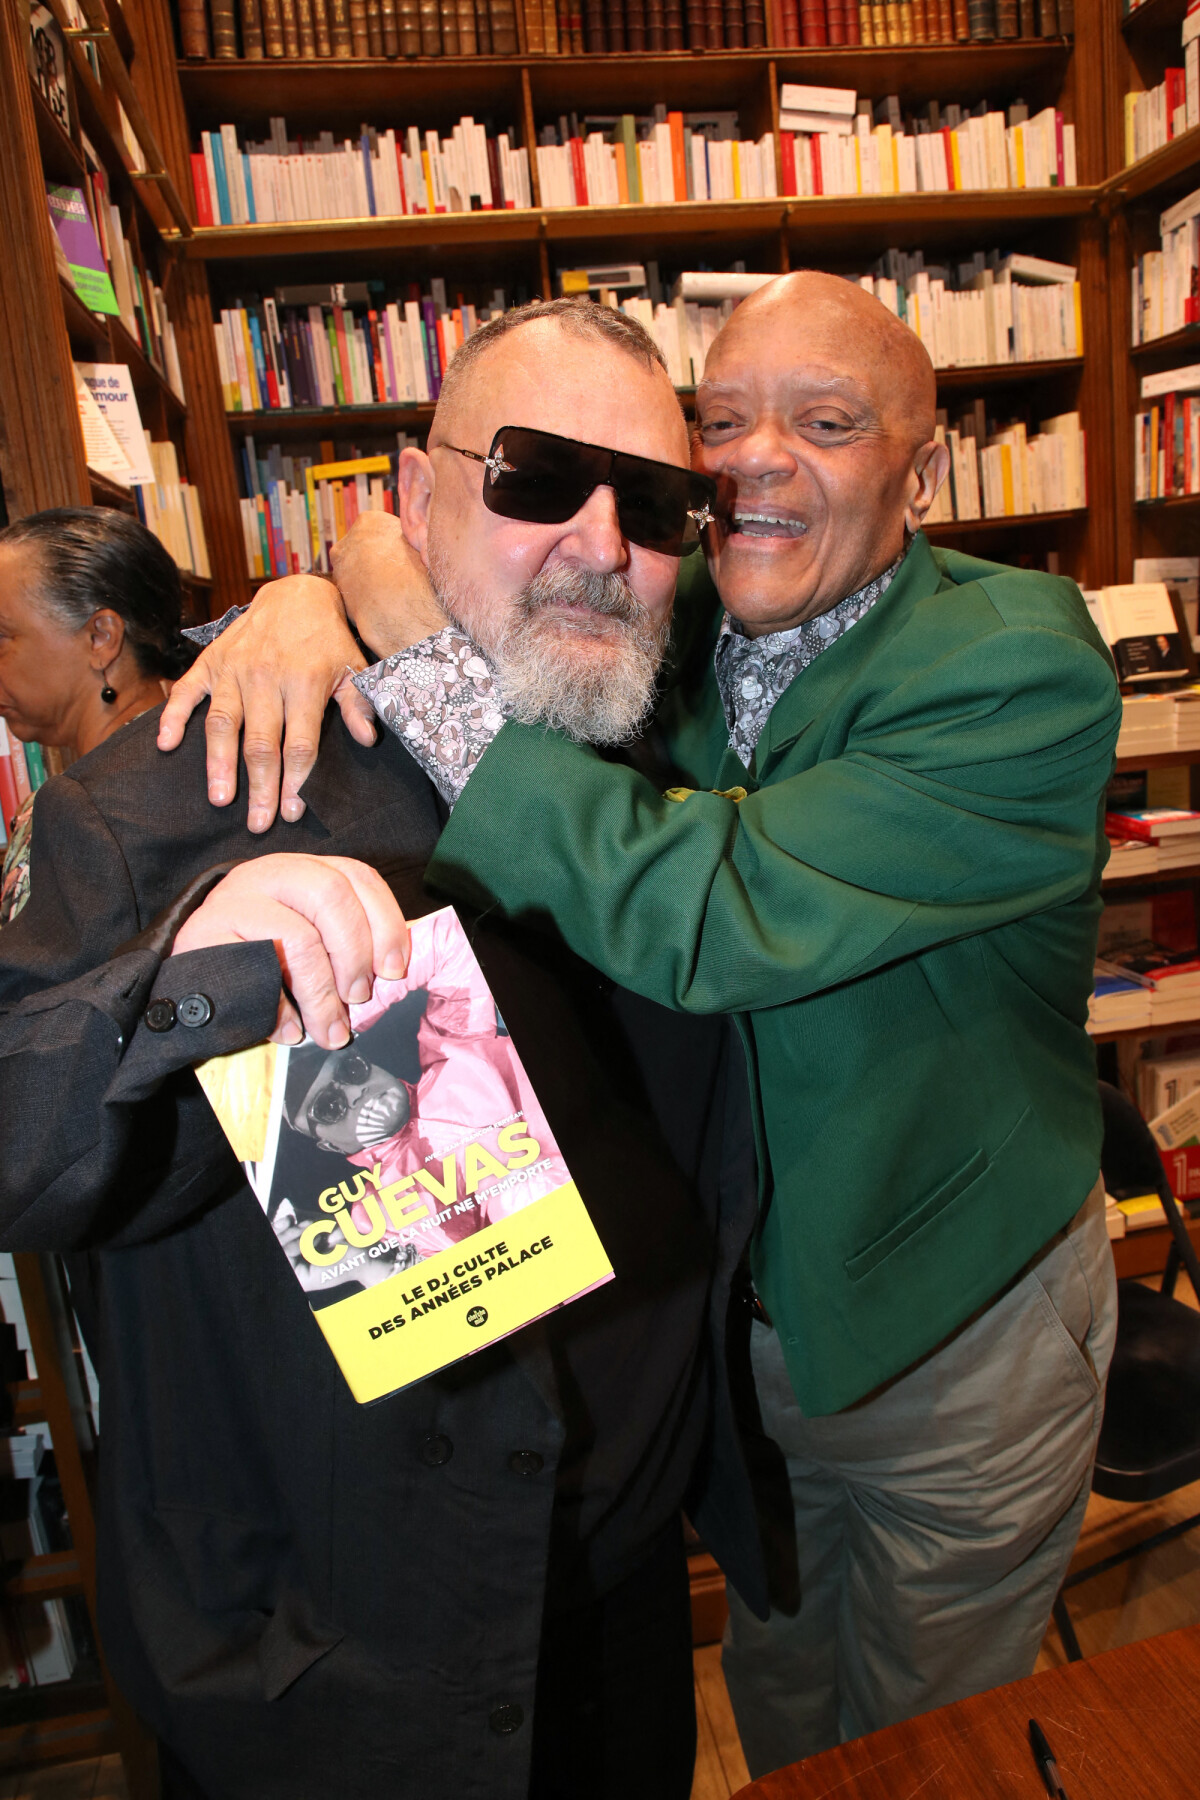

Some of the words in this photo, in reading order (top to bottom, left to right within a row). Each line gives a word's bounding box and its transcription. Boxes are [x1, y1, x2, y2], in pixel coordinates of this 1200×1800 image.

[108, 376, 120, 388] de
[424, 1148, 443, 1163] AVEC
[299, 1121, 541, 1267] CUEVAS
[318, 1162, 383, 1214] GUY
[320, 1252, 366, 1284] AVANT
[368, 1236, 400, 1258] QUE
[399, 1226, 420, 1243] LA
[419, 1208, 452, 1233] NUIT
[453, 1197, 475, 1215] NE
[474, 1157, 554, 1205] M'EMPORTE
[368, 1314, 406, 1340] DES
[411, 1274, 483, 1321] ANNÉES
[484, 1235, 554, 1281] PALACE
[401, 1285, 426, 1305] LE
[426, 1272, 450, 1292] DJ
[453, 1241, 509, 1278] CULTE
